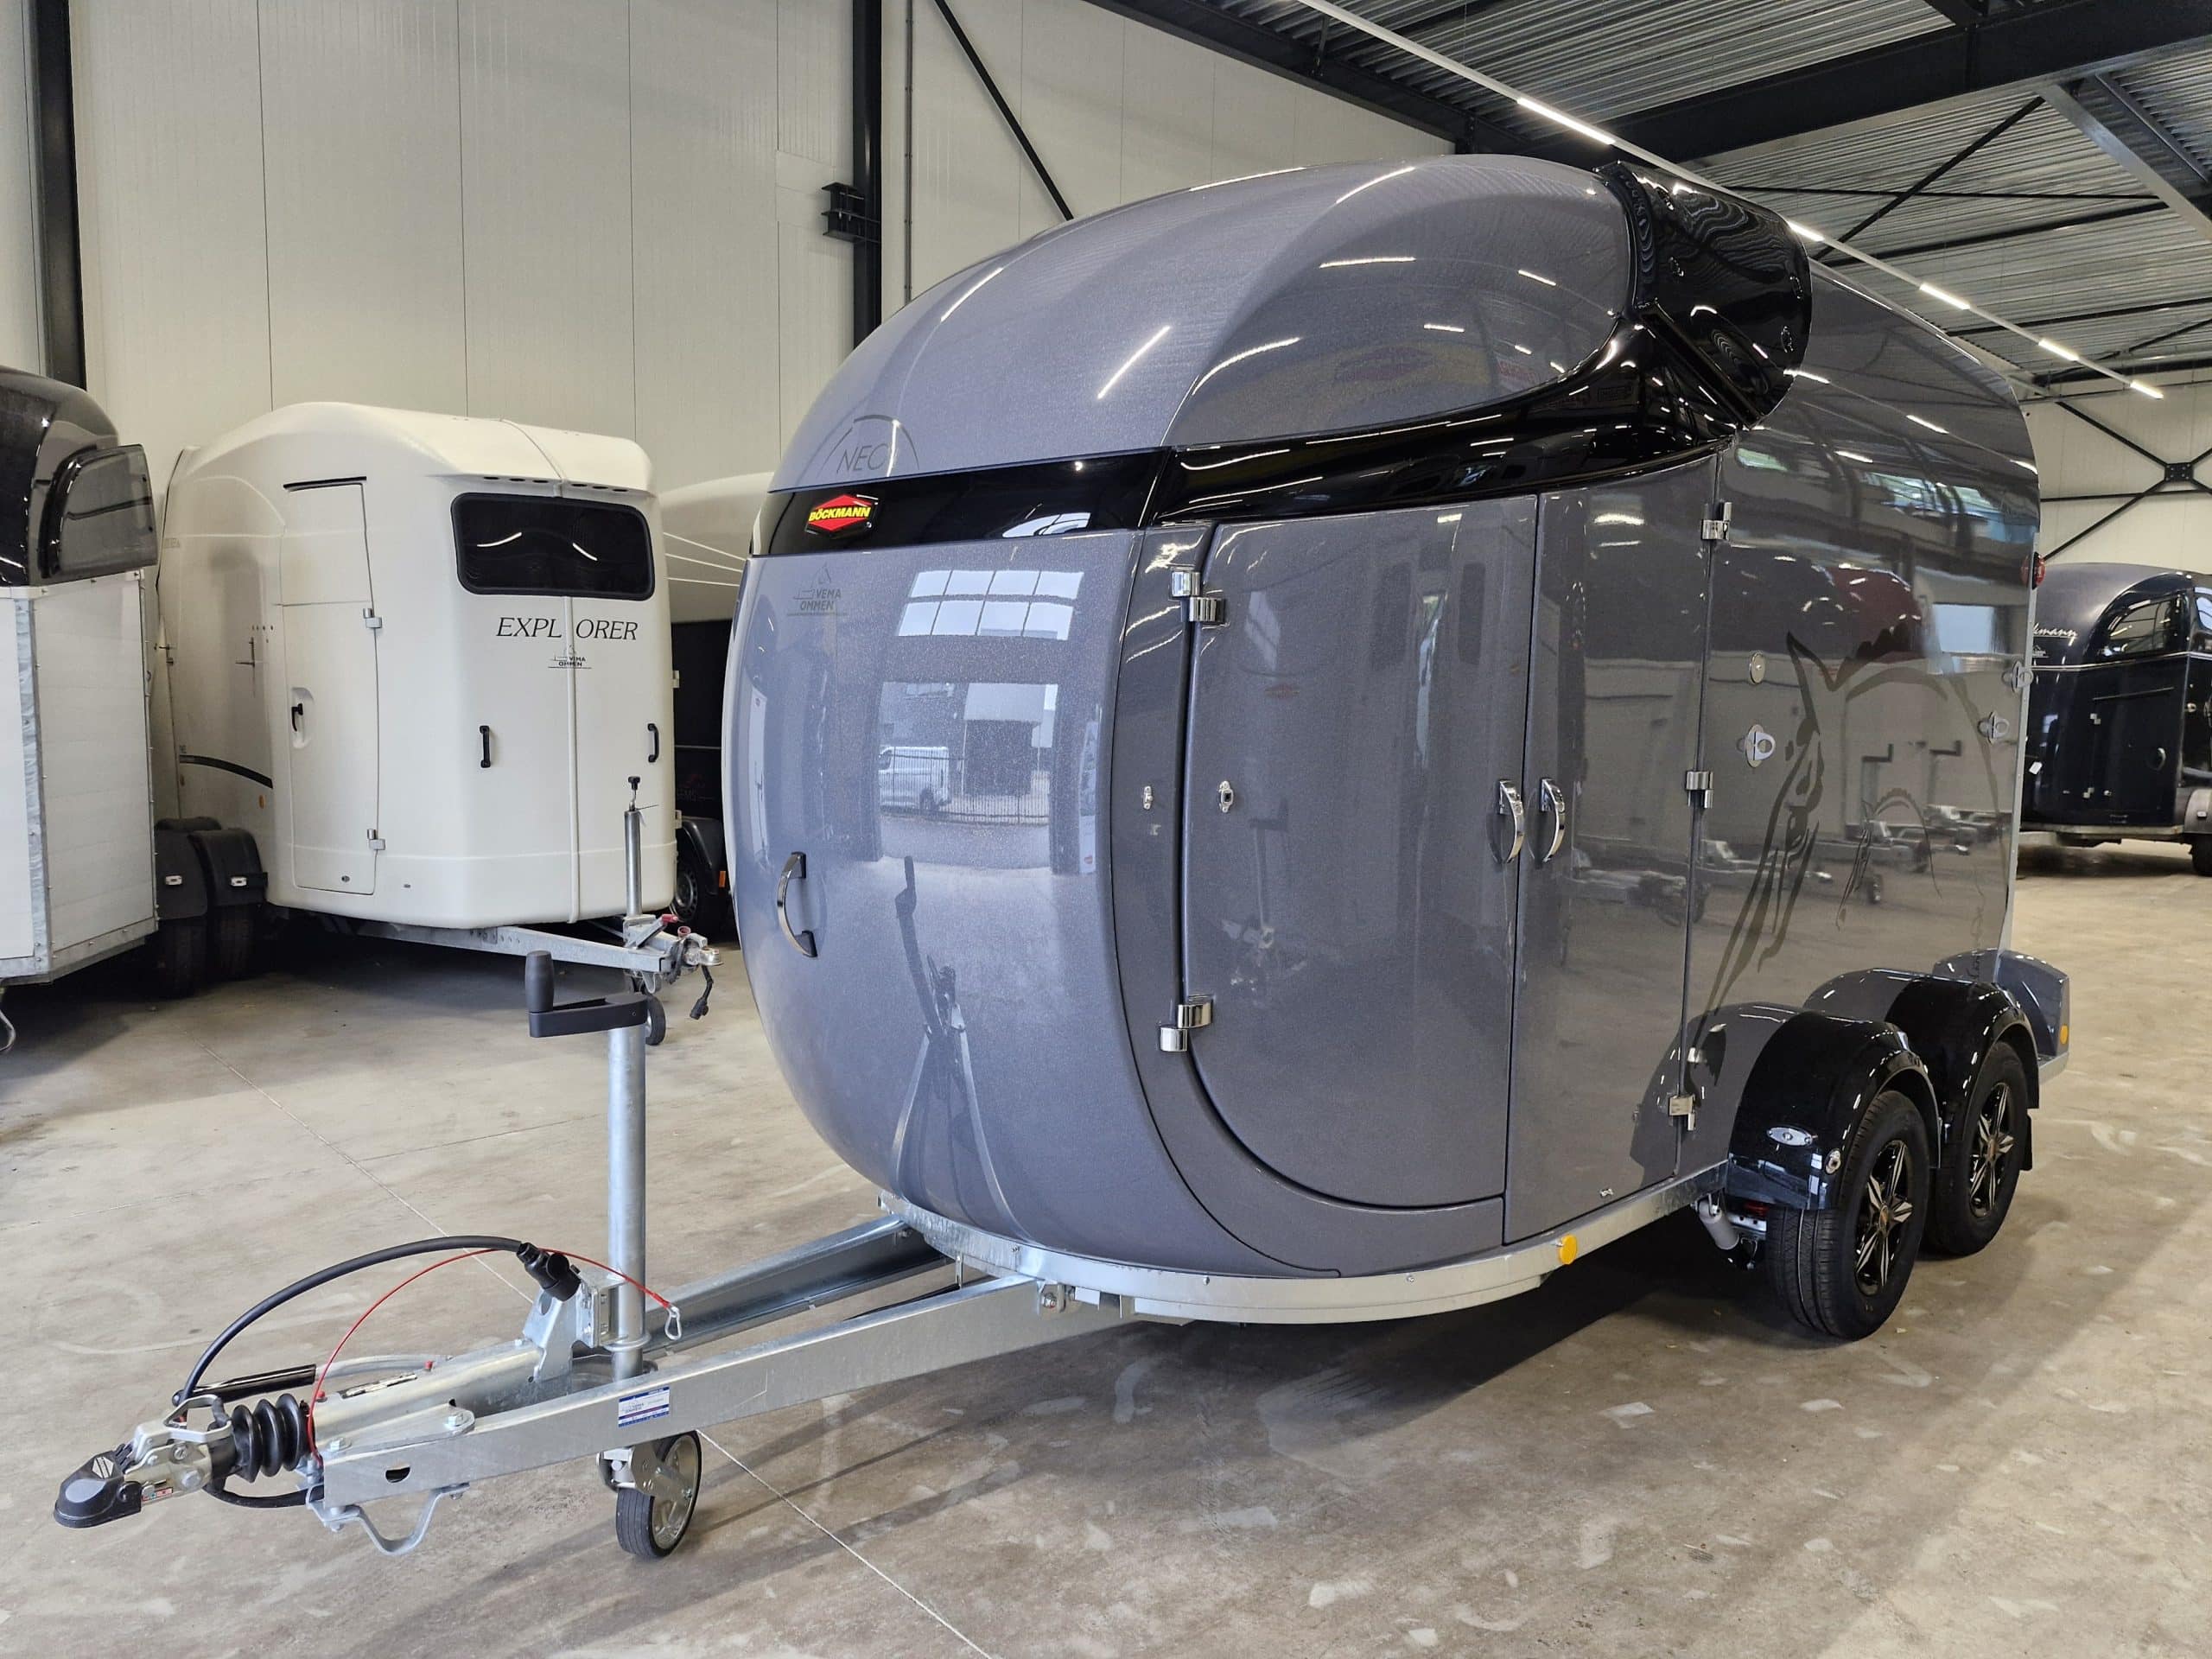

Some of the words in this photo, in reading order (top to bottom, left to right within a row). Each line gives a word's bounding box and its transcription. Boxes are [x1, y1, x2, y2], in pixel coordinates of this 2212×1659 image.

[808, 506, 871, 522] BÖCKMANN
[816, 588, 842, 600] VEMA
[800, 600, 836, 611] OMMEN
[495, 617, 639, 640] EXPLORER
